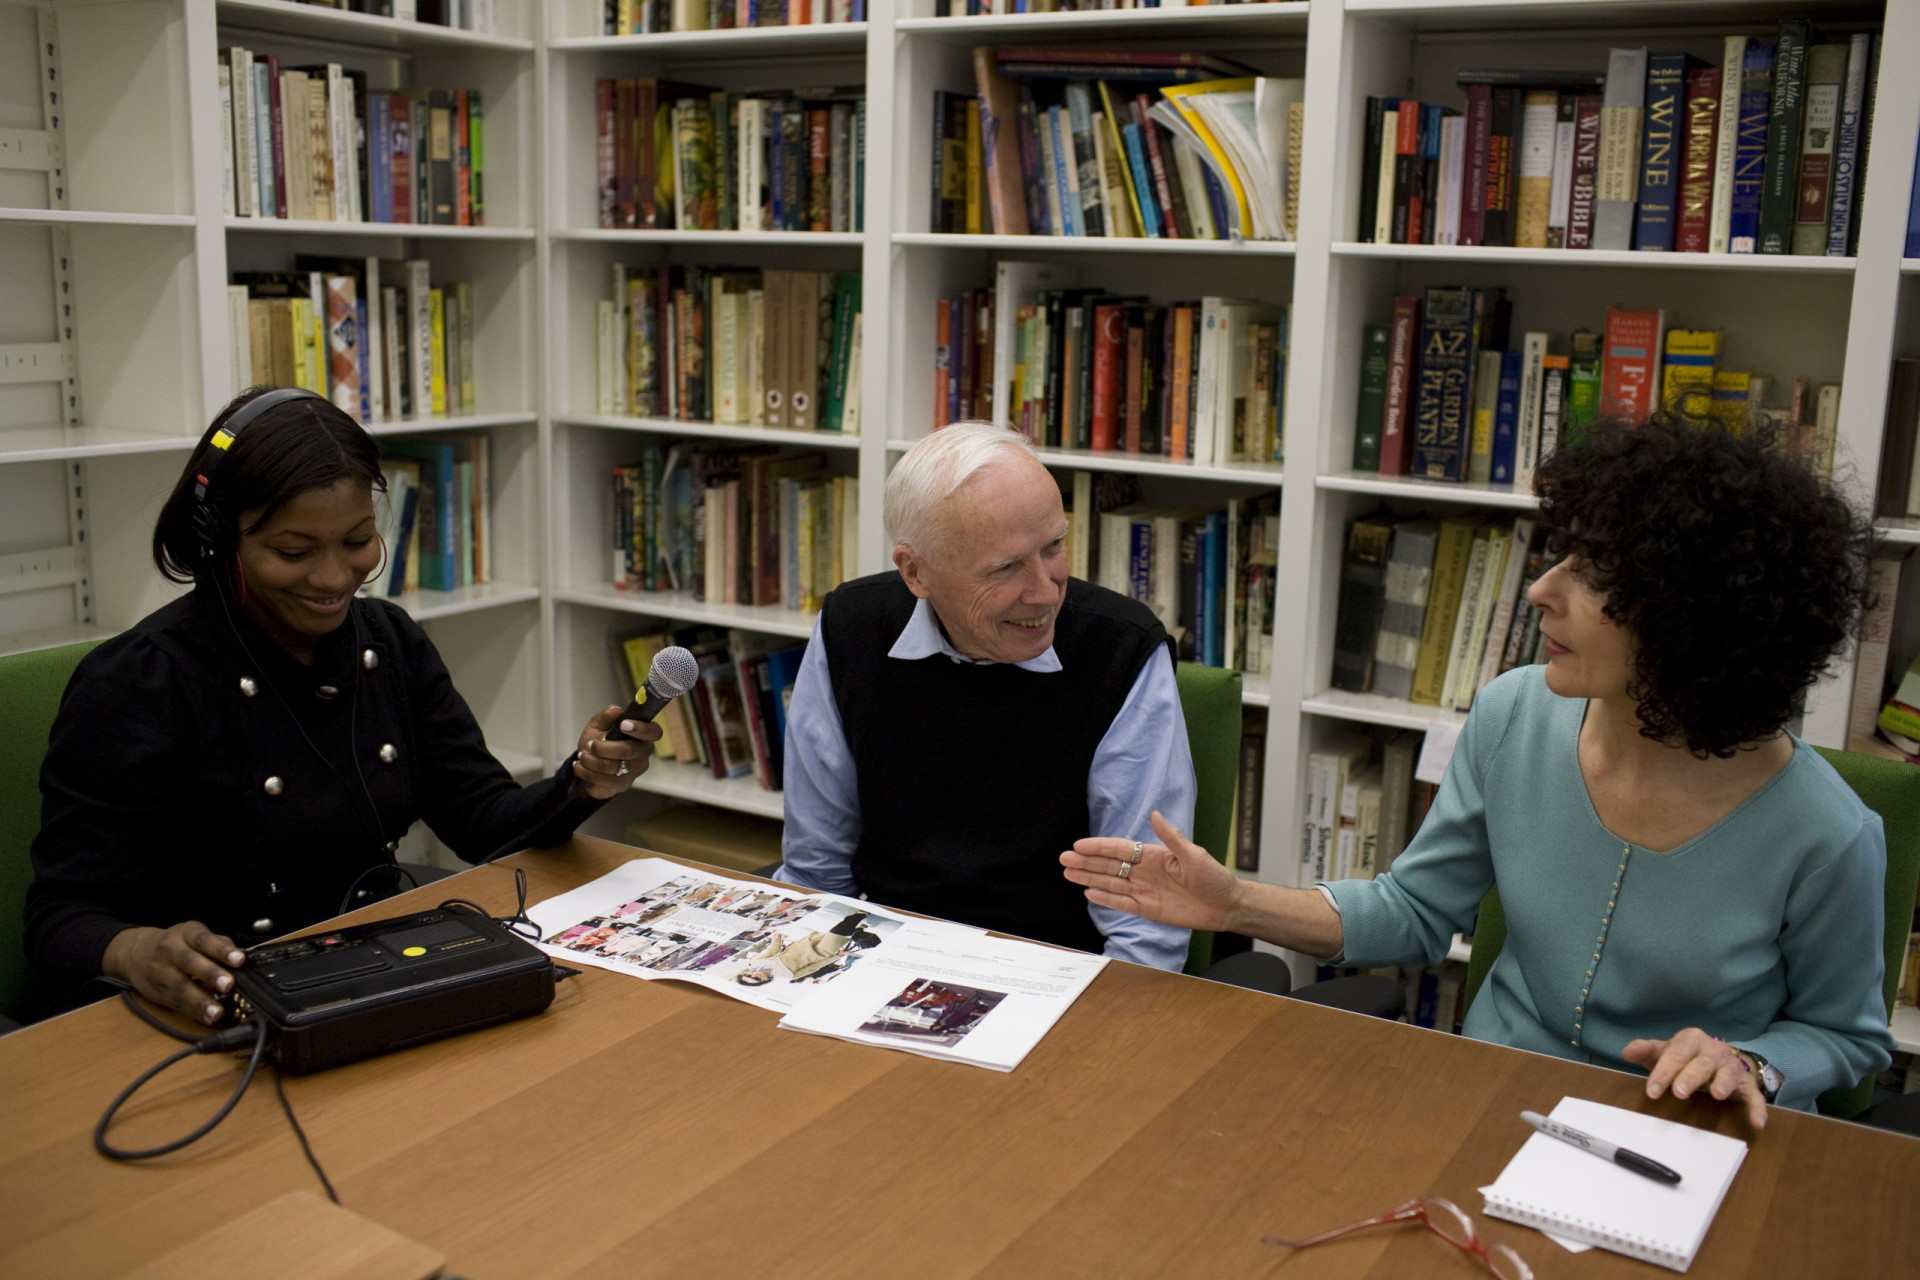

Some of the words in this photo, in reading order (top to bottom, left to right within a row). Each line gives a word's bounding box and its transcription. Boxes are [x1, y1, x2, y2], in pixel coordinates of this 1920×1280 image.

[1779, 36, 1792, 53] OF
[1789, 45, 1805, 73] Wine
[1726, 55, 1739, 90] WINE
[1773, 52, 1790, 117] CALIFORNIA
[1785, 76, 1801, 109] Atlas
[1722, 94, 1737, 131] ATLAS
[1840, 109, 1858, 155] FRANCE
[1577, 114, 1598, 169] WINE
[1645, 95, 1675, 187] WINE
[1687, 97, 1718, 178] CALIFORNIA
[1734, 112, 1769, 194] WINE
[1778, 124, 1789, 152] JAMES
[1488, 135, 1501, 183] ITALIANO
[1719, 142, 1732, 175] ITALY
[1774, 154, 1785, 196] HALLIDAY
[1486, 185, 1498, 210] VINO
[1684, 181, 1711, 219] WINE
[1835, 176, 1851, 206] ATLAS
[1571, 184, 1594, 247] BIBLE
[1832, 208, 1848, 233] WINE
[1828, 236, 1845, 255] THE
[1393, 318, 1409, 364] National
[1424, 330, 1467, 356] A-Z
[1610, 336, 1650, 344] ROBERT
[1388, 365, 1403, 405] Garden
[1385, 407, 1400, 436] Book
[1417, 369, 1444, 445] PLANTS
[1440, 368, 1466, 446] GARDEN
[1302, 822, 1316, 864] Ceramics
[1315, 826, 1331, 882] Silverware
